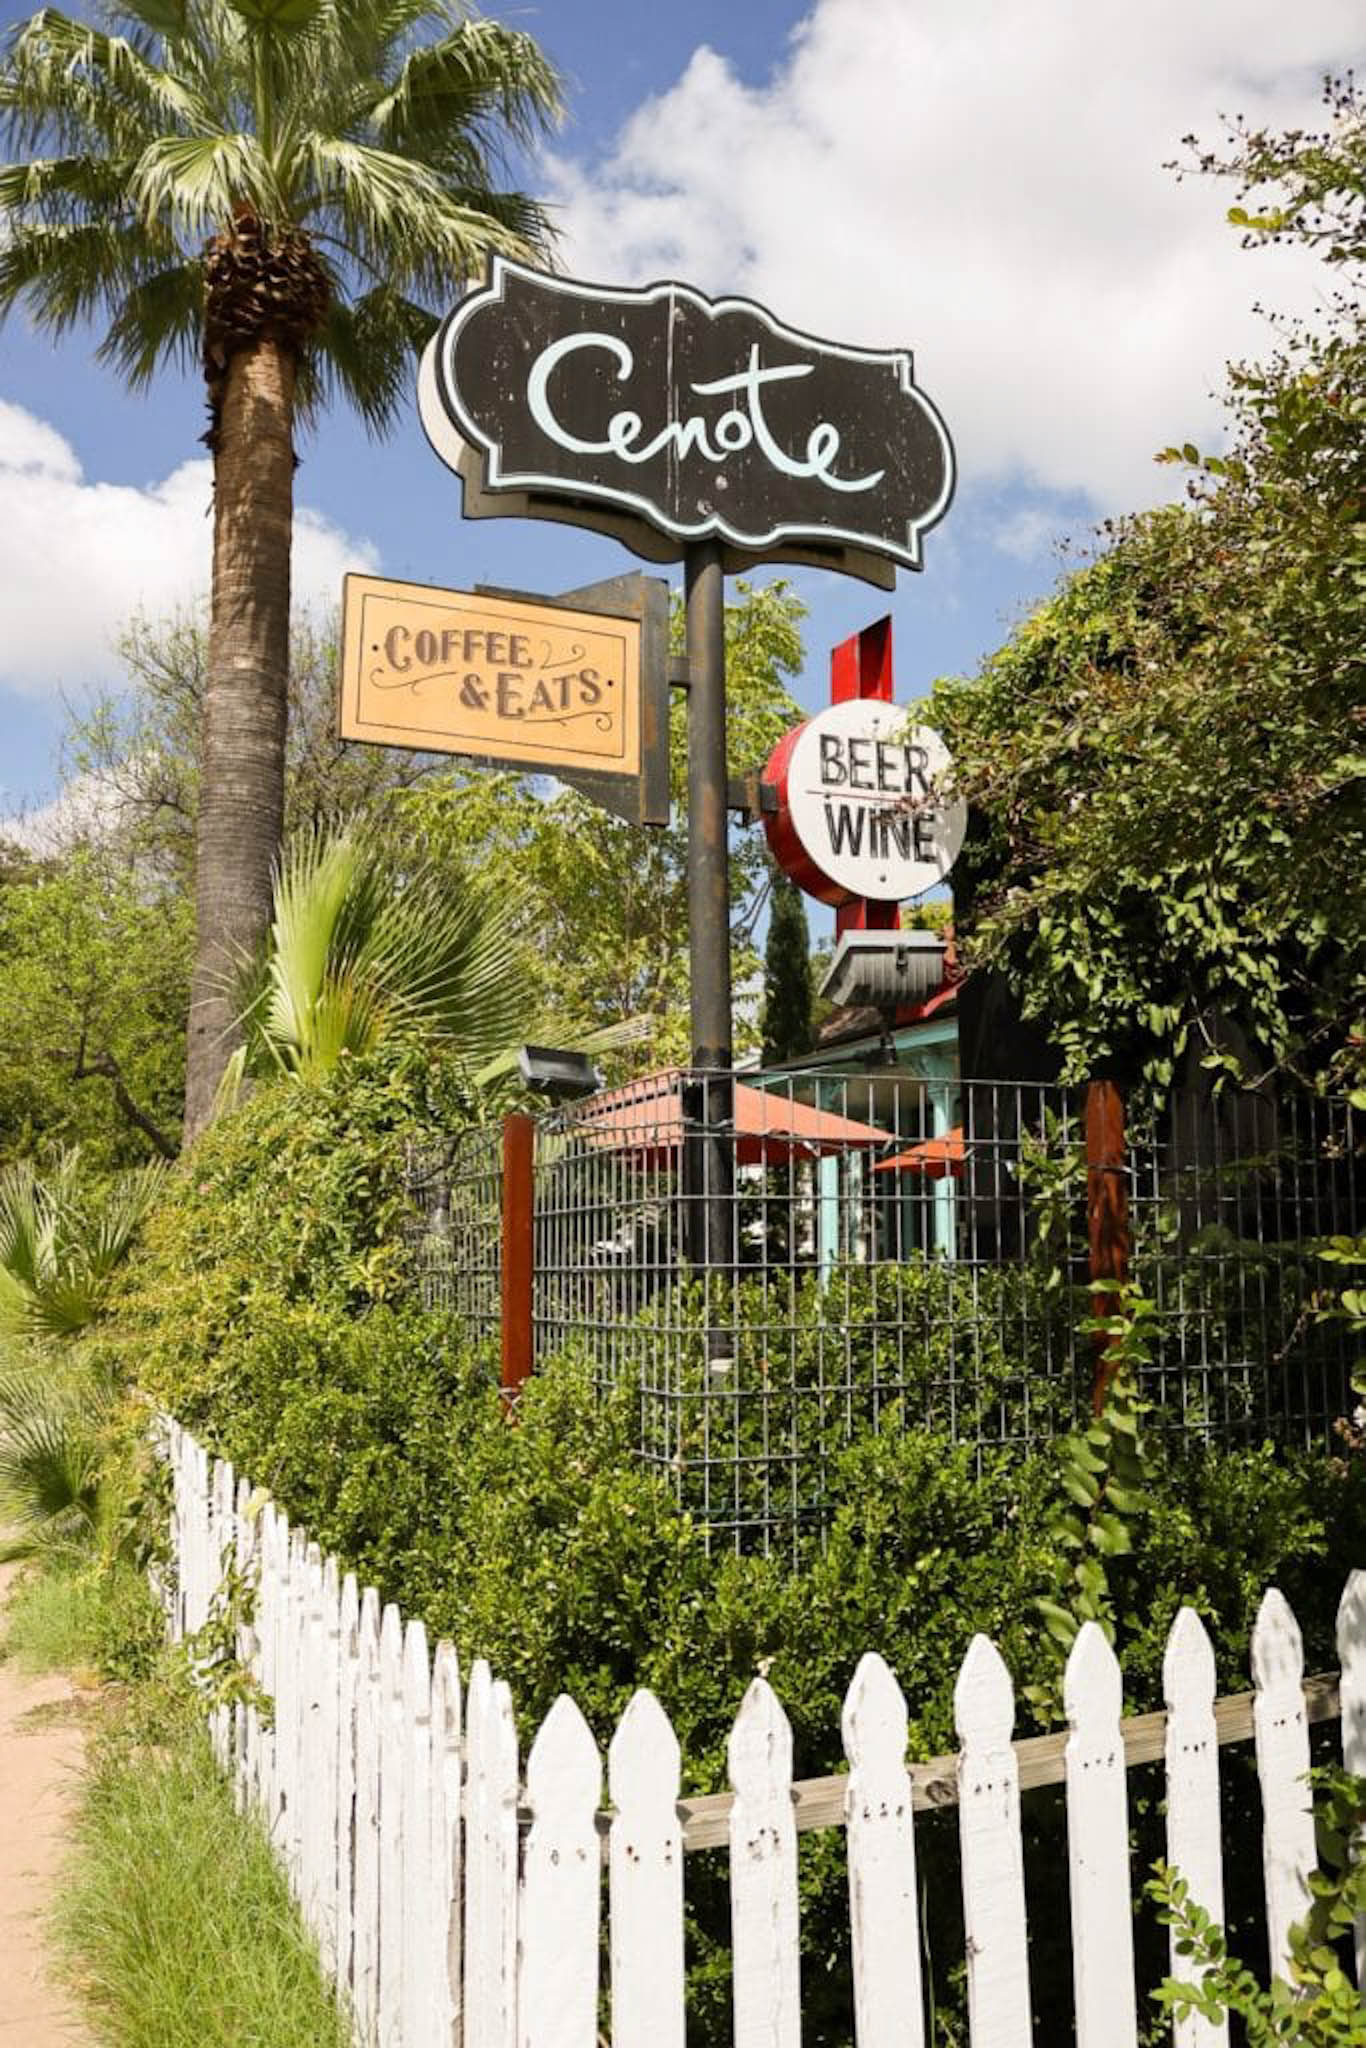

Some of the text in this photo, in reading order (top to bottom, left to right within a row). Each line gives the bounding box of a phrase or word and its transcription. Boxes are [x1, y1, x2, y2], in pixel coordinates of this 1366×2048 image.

[527, 332, 885, 492] Cenote
[384, 625, 534, 673] COFFEE
[819, 733, 931, 794] BEER
[824, 803, 937, 863] WINE
